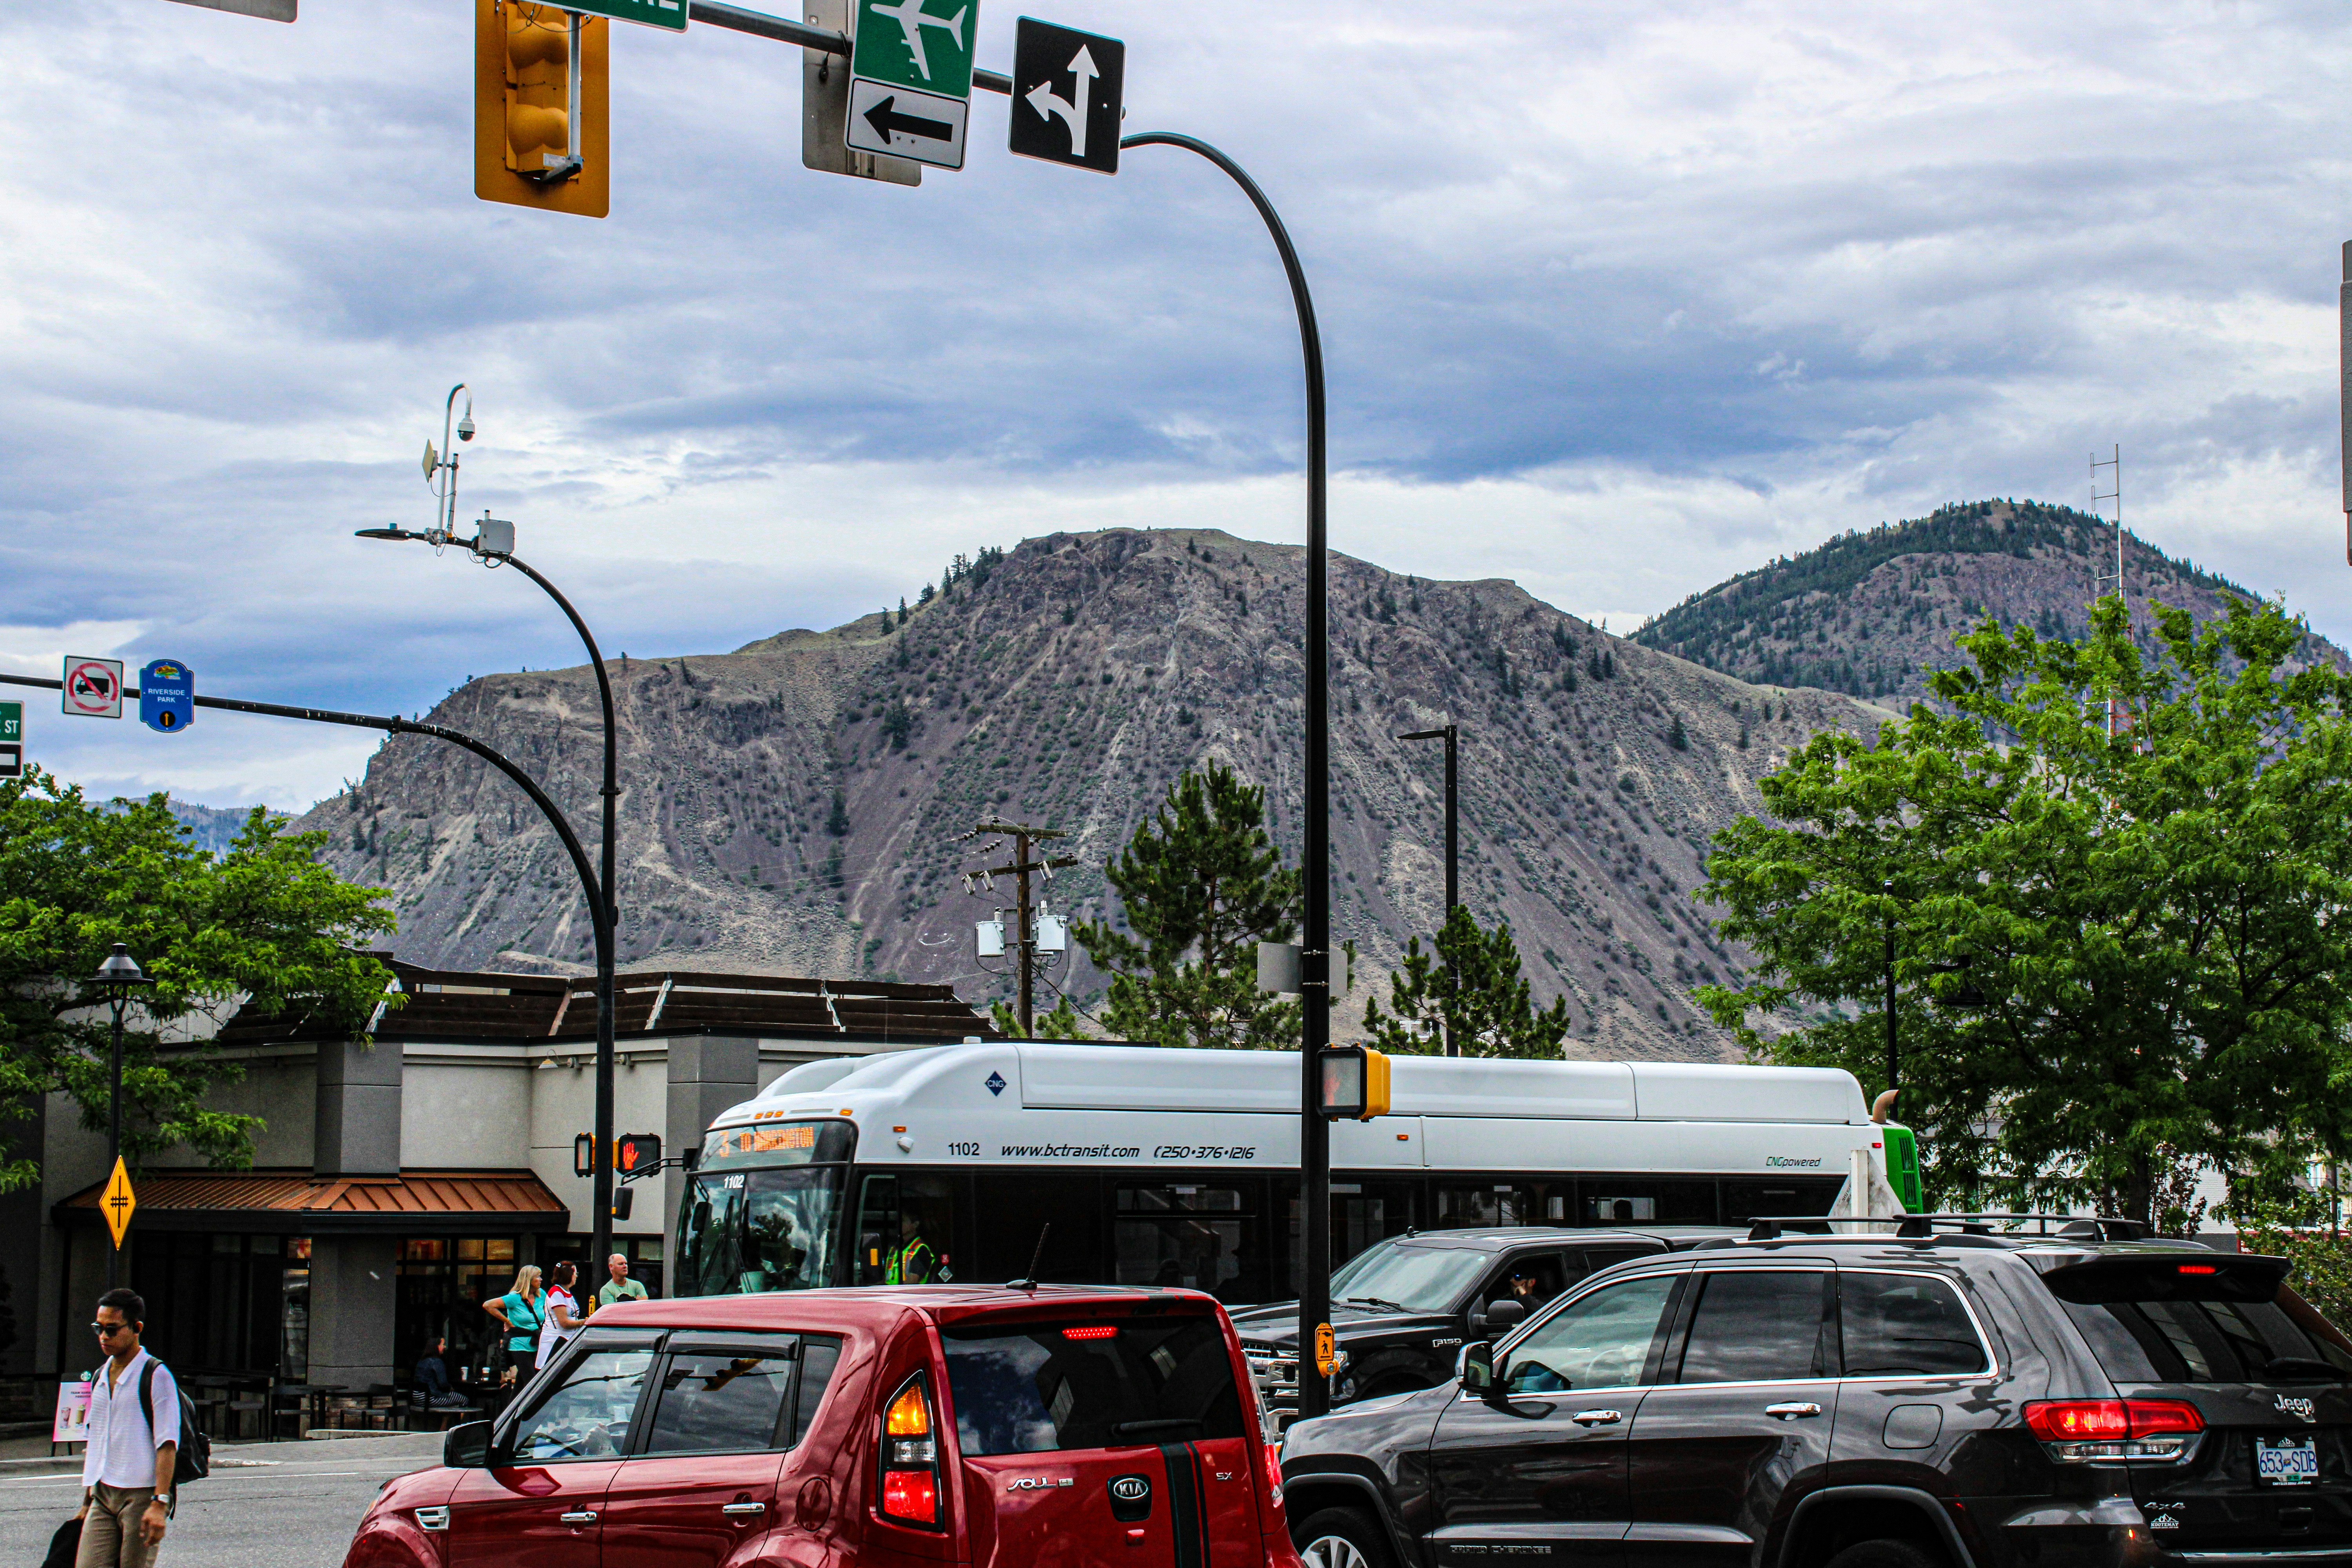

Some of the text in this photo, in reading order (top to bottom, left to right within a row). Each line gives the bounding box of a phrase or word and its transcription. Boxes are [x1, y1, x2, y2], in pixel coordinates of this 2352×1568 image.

[4, 720, 19, 733] ST
[719, 1131, 730, 1157] 3
[739, 1132, 751, 1152] TO
[948, 1142, 980, 1156] 1102
[1002, 1143, 1140, 1157] www.bctransit.com
[1766, 1156, 1821, 1168] CNGpowered
[724, 1174, 745, 1189] 1102
[1432, 1338, 1462, 1347] F150
[2274, 1394, 2314, 1415] Jeep
[2259, 1450, 2318, 1473] 653 SDB
[1216, 1472, 1233, 1480] SX
[1007, 1477, 1056, 1491] SOUL
[1119, 1483, 1143, 1495] KIA
[1450, 1545, 1552, 1554] GRAND CHEROKEE
